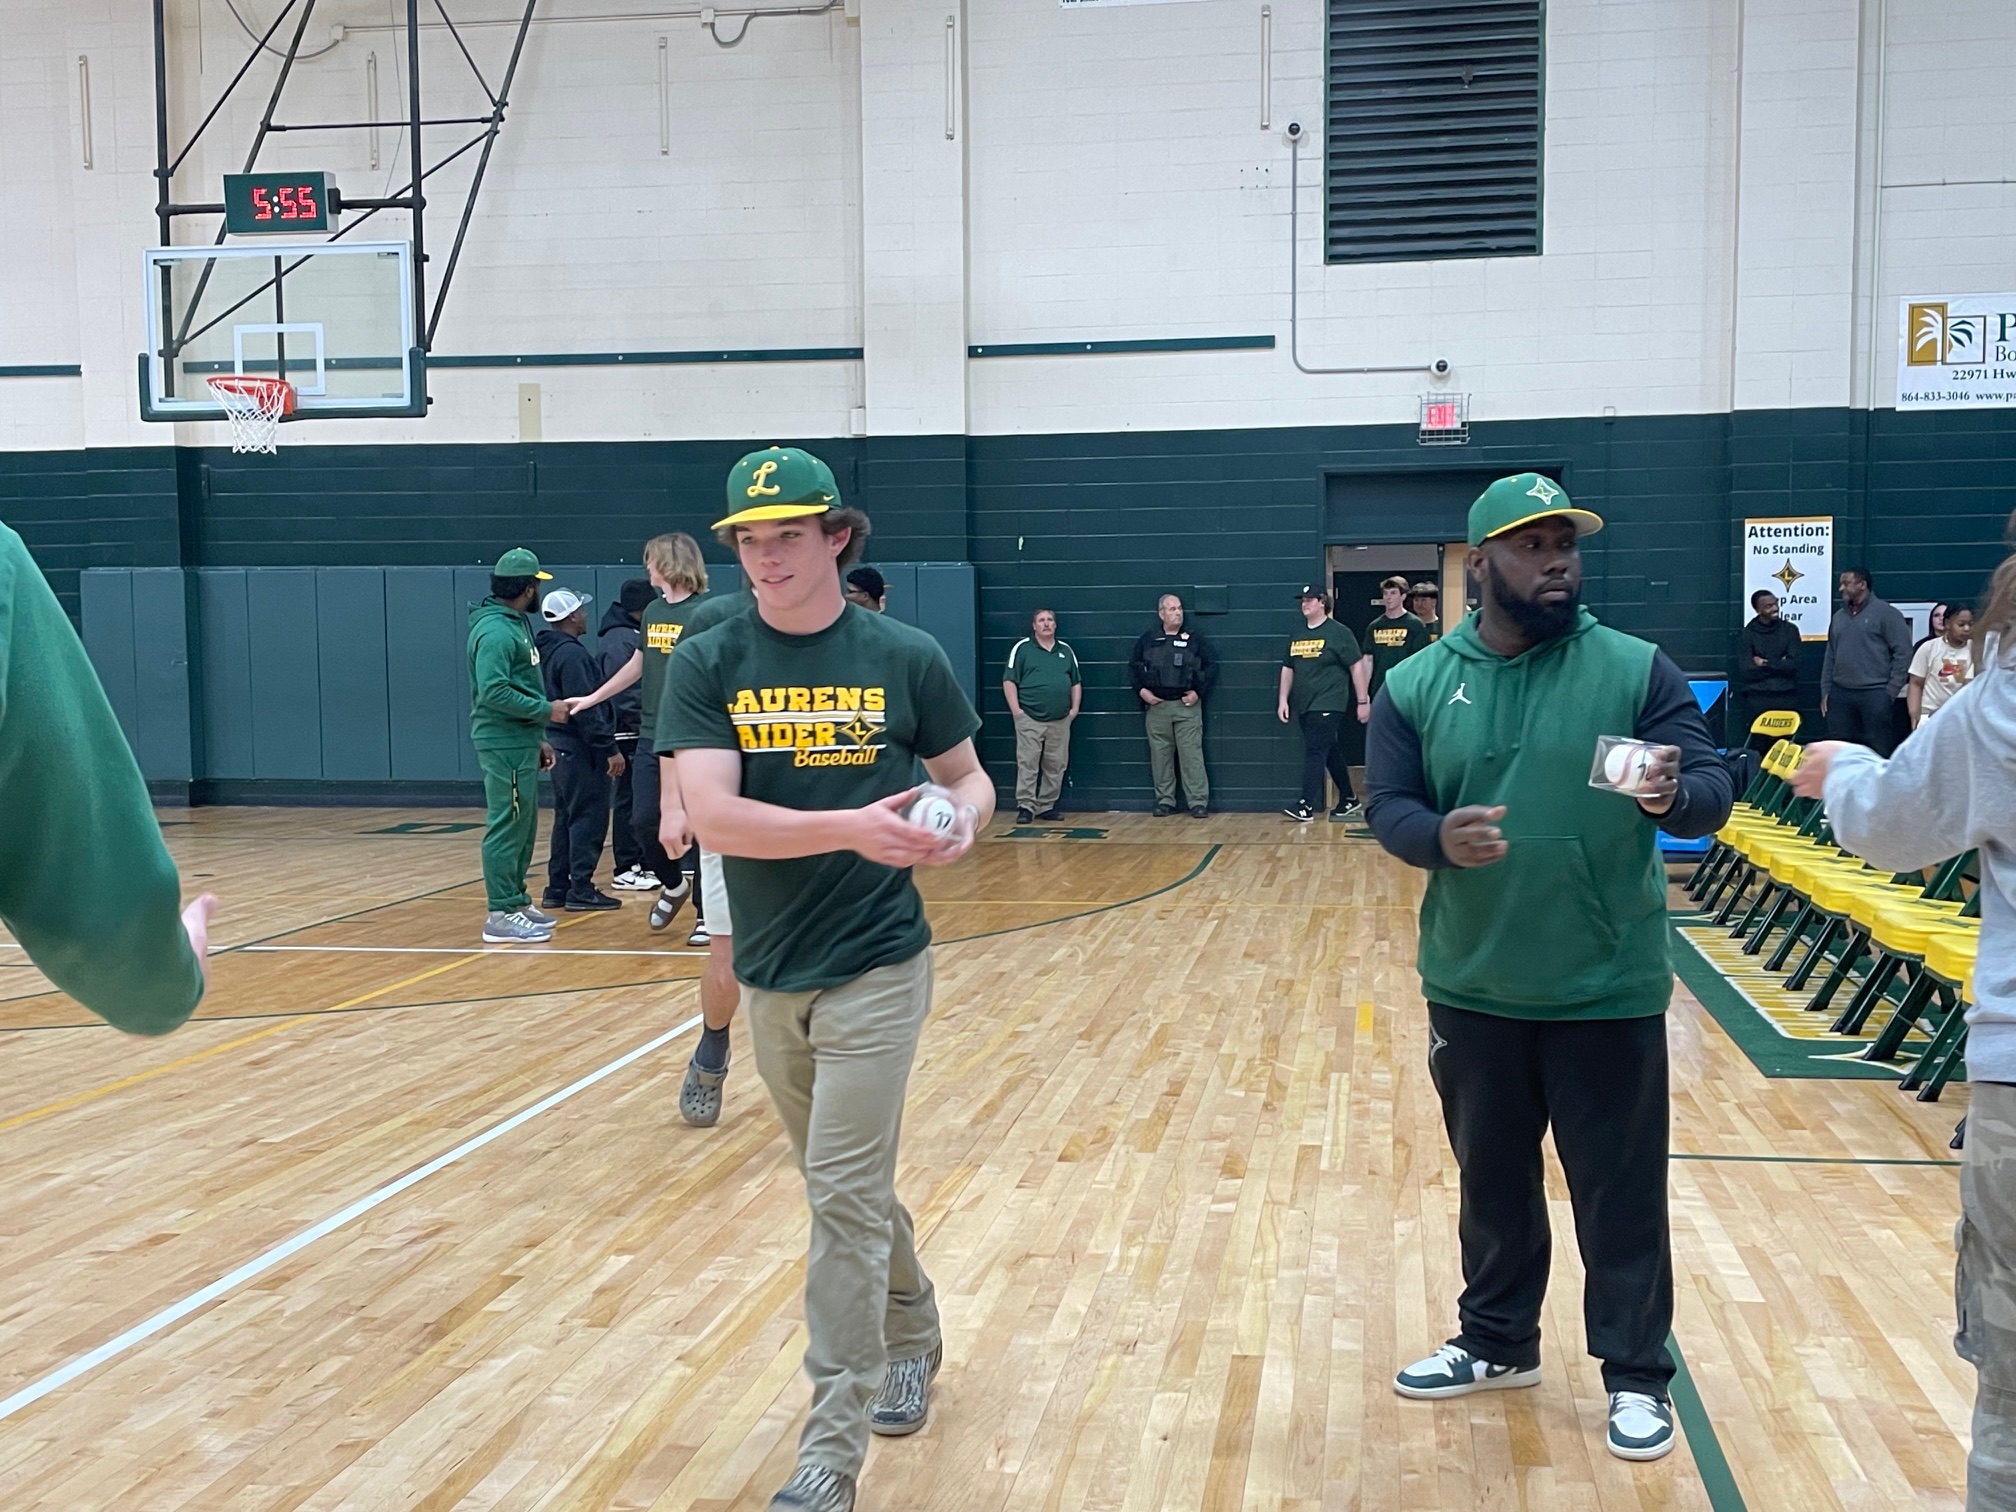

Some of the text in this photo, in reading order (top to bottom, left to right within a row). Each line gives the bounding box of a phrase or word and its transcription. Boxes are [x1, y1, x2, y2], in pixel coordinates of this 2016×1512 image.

[253, 187, 317, 220] 5:55
[1952, 369, 1988, 381] 22971
[1901, 391, 1970, 402] 864-833-3046
[747, 461, 780, 498] L
[1748, 524, 1830, 538] Attention:
[1753, 543, 1825, 556] No Standing
[1784, 569, 1793, 580] L
[1790, 595, 1818, 604] Area
[1780, 611, 1803, 621] lear
[727, 686, 886, 713] AURENS
[737, 722, 837, 749] AIDER
[794, 745, 878, 768] Baseball
